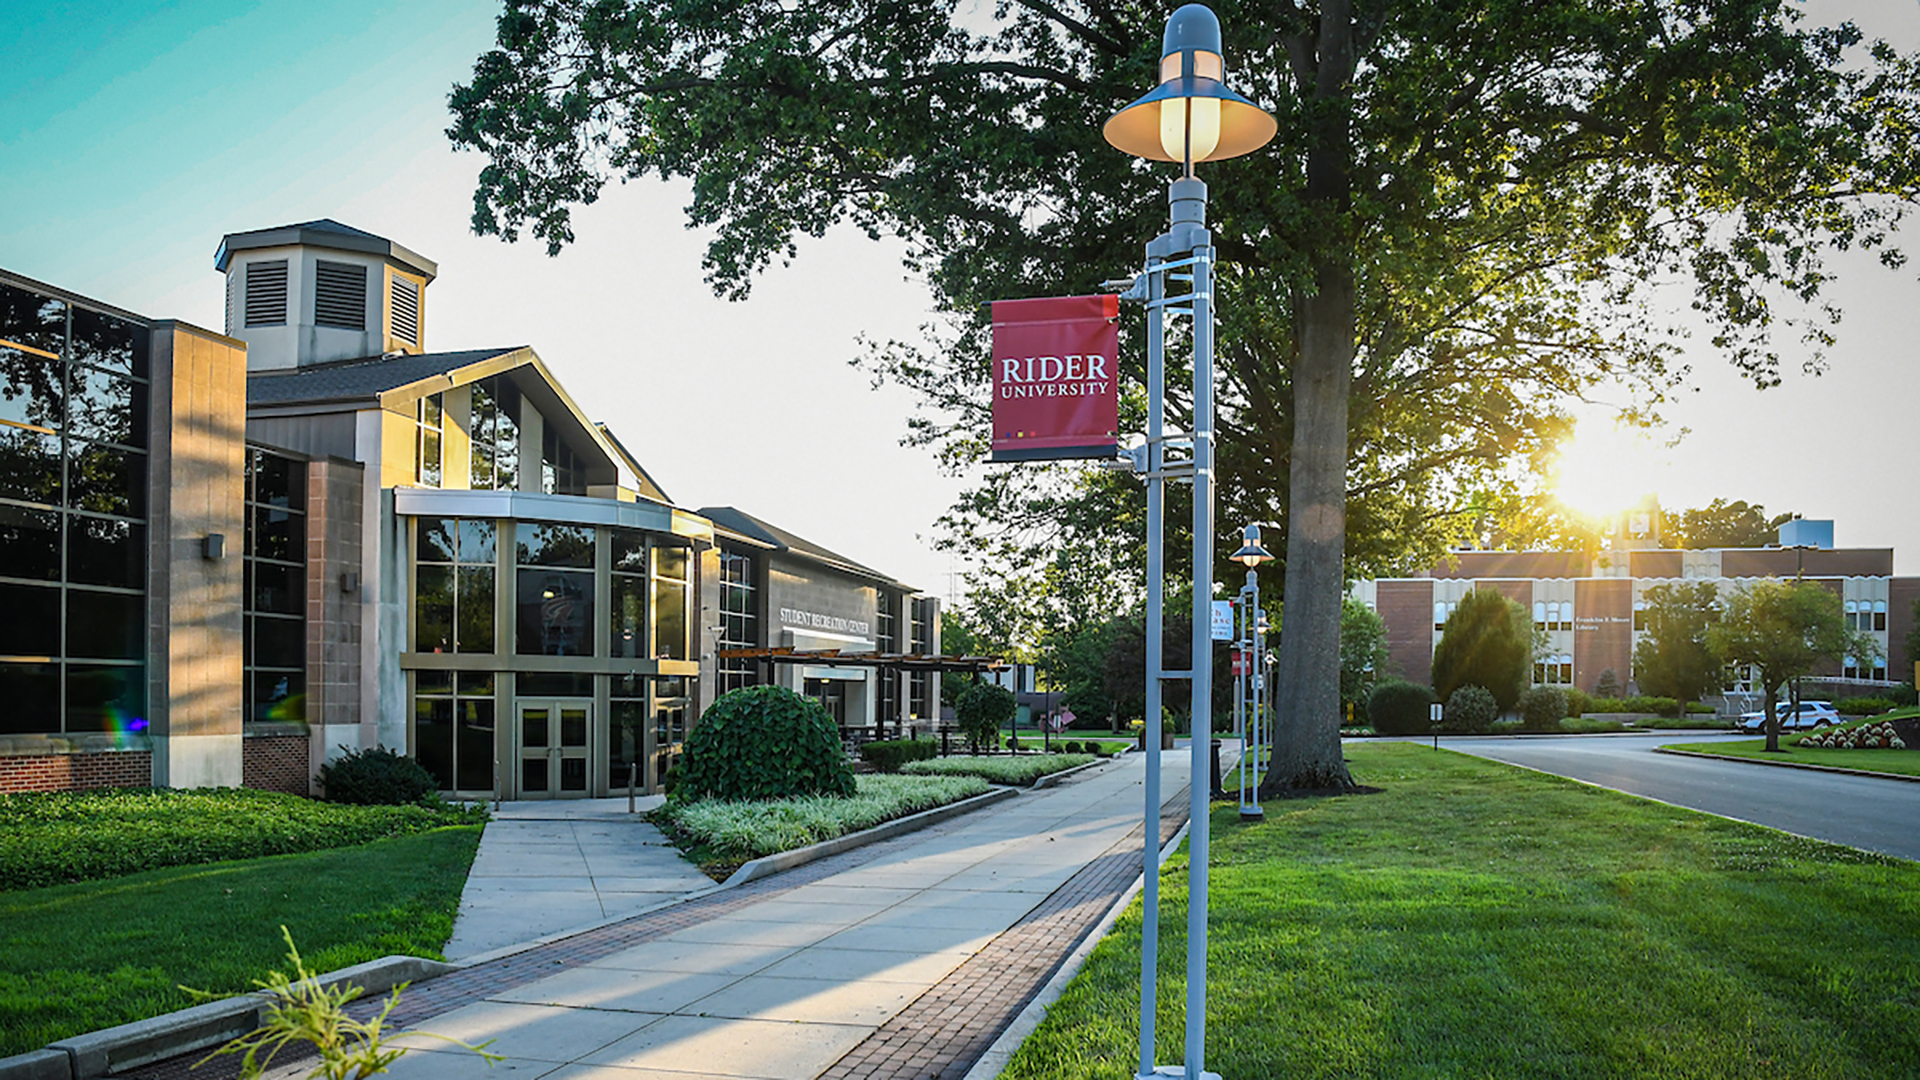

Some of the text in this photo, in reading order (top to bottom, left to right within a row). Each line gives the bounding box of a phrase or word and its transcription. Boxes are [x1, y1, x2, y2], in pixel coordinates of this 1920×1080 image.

[1001, 355, 1109, 383] RIDER
[1001, 382, 1109, 399] UNIVERSITY
[780, 607, 869, 634] STUDENT RECREATION CENTER
